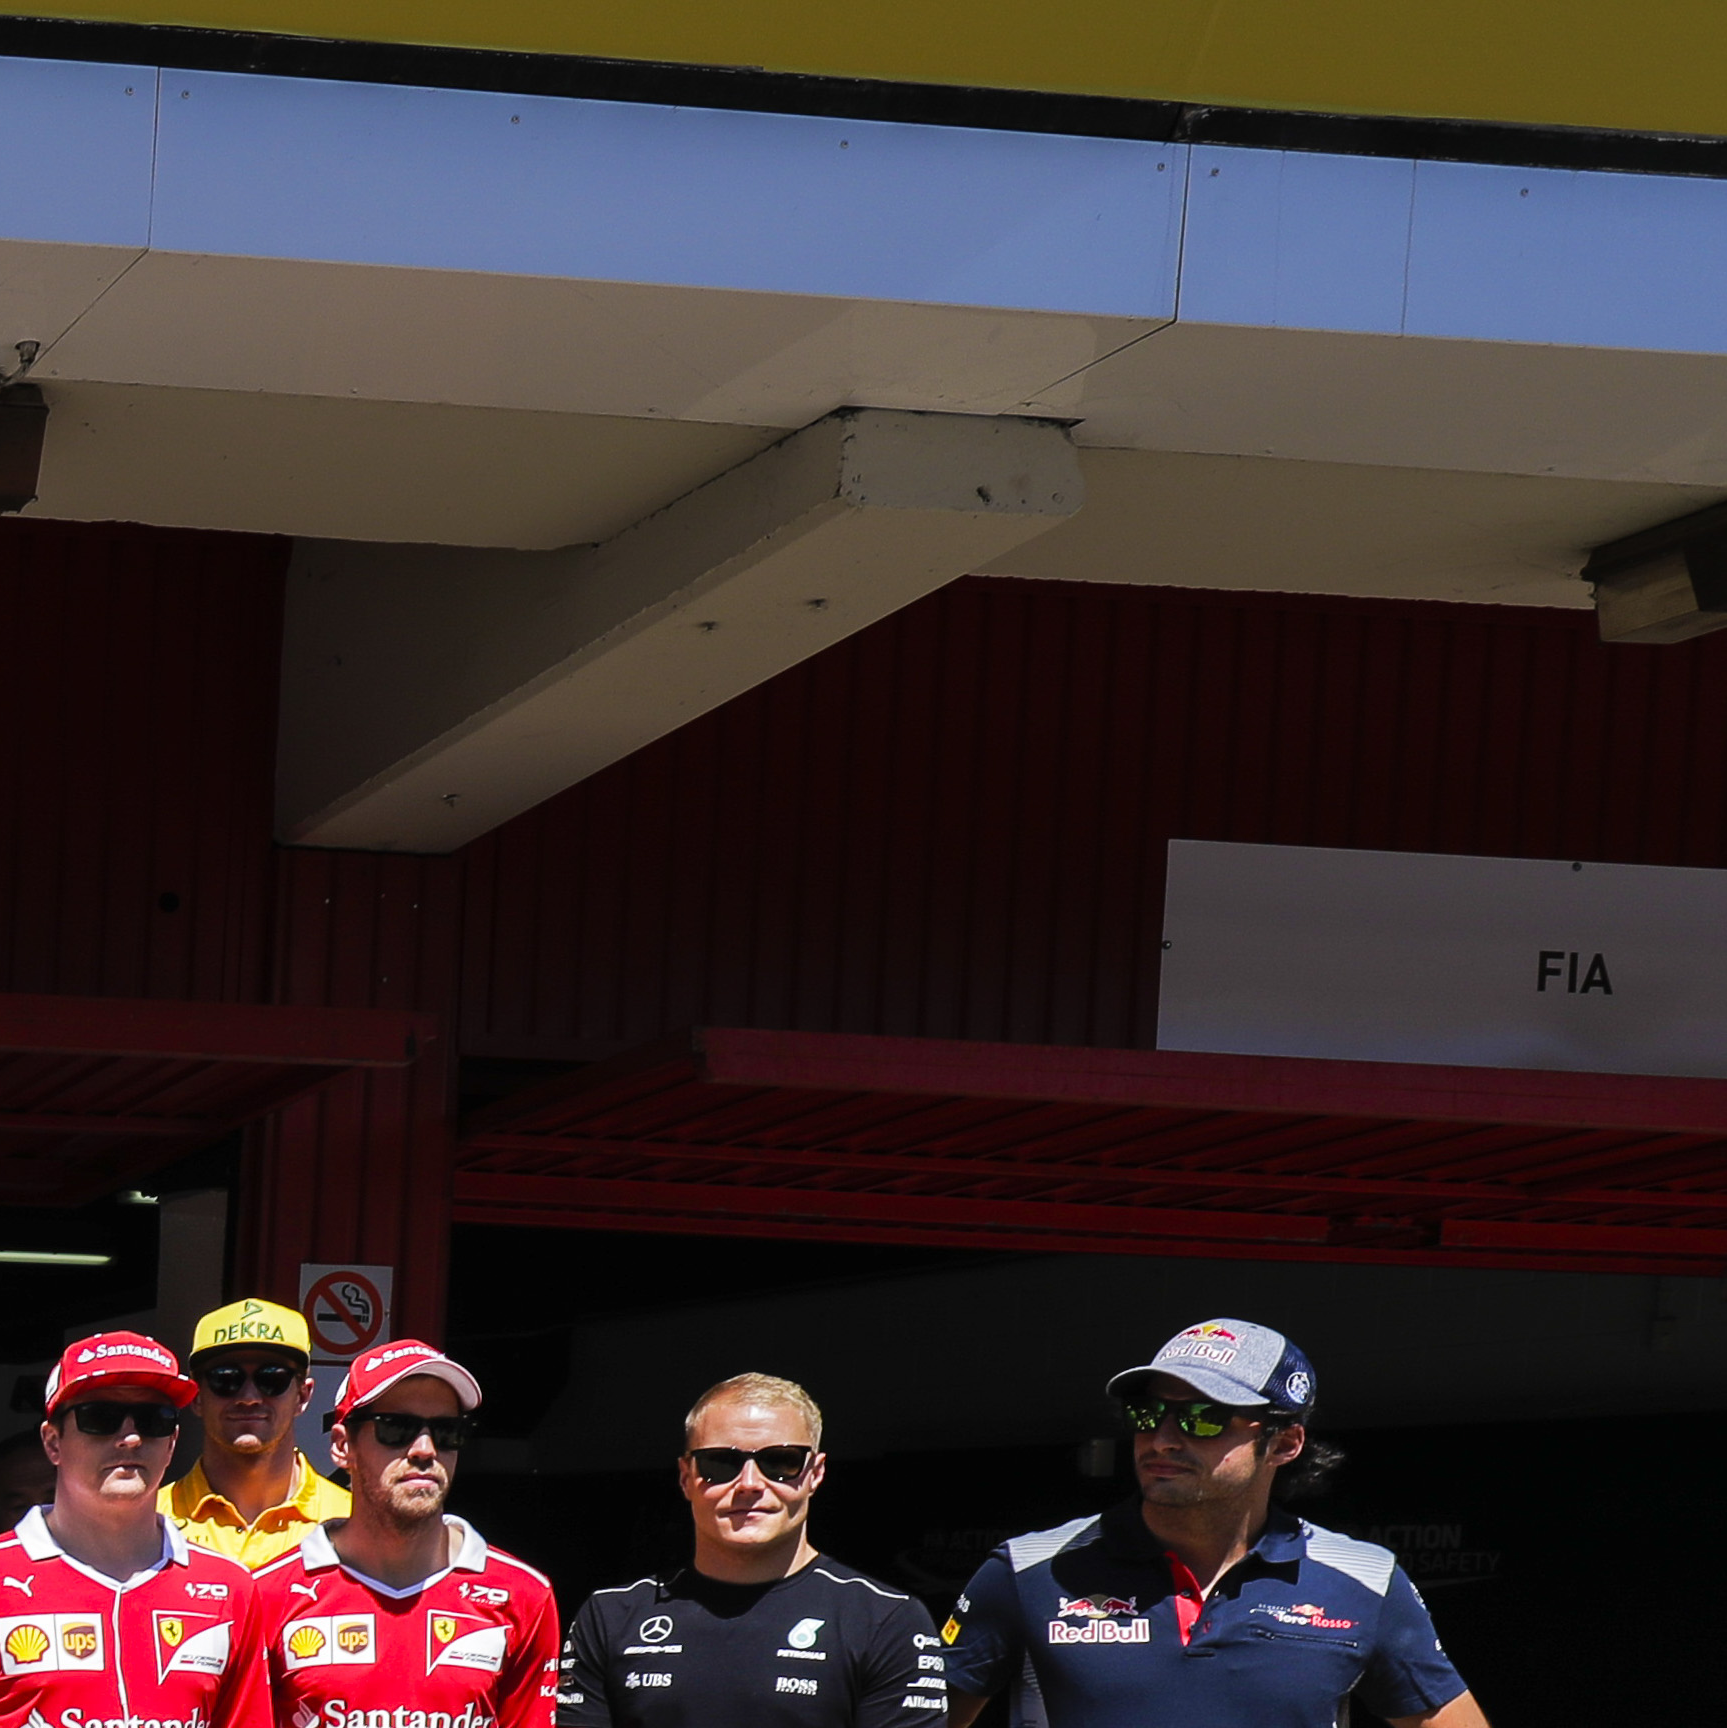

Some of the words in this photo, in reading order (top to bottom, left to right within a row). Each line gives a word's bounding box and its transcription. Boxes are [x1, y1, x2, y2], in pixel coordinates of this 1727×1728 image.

[1537, 951, 1613, 995] FIA
[215, 1320, 284, 1343] DEKRA
[96, 1342, 172, 1368] Santander
[1194, 1343, 1237, 1366] Bull
[195, 1583, 229, 1596] 70
[471, 1585, 509, 1602] 70
[339, 1630, 367, 1652] ups
[1050, 1622, 1096, 1642] Red
[1100, 1620, 1149, 1641] Bull
[64, 1632, 95, 1656] ups
[777, 1649, 826, 1660] PETRONAS
[643, 1673, 672, 1687] UBS
[776, 1676, 817, 1691] BOSS
